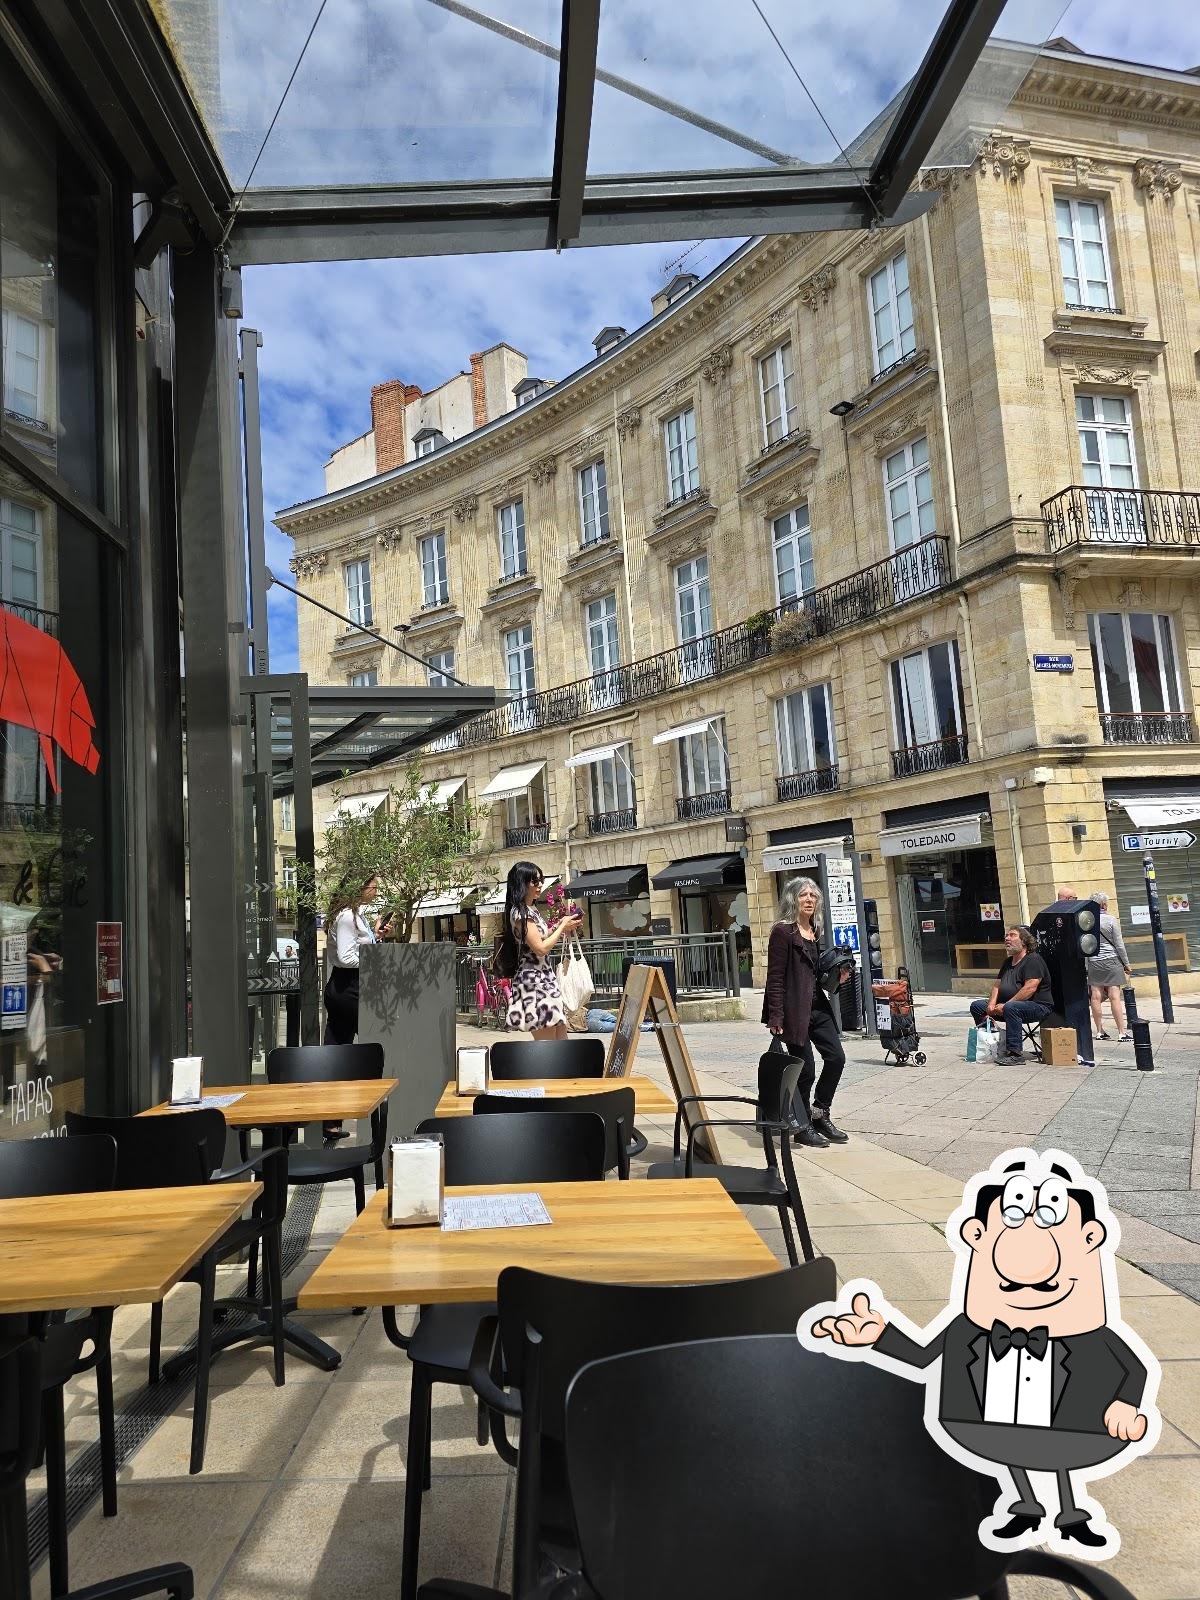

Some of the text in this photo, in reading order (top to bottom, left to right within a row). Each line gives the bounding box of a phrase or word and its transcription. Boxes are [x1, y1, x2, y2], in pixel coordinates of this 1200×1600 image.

[900, 832, 956, 849] TOLEDANO
[1129, 836, 1179, 848] P Tourny
[778, 853, 819, 867] TOLEDAN
[8, 1075, 53, 1127] TAPAS
